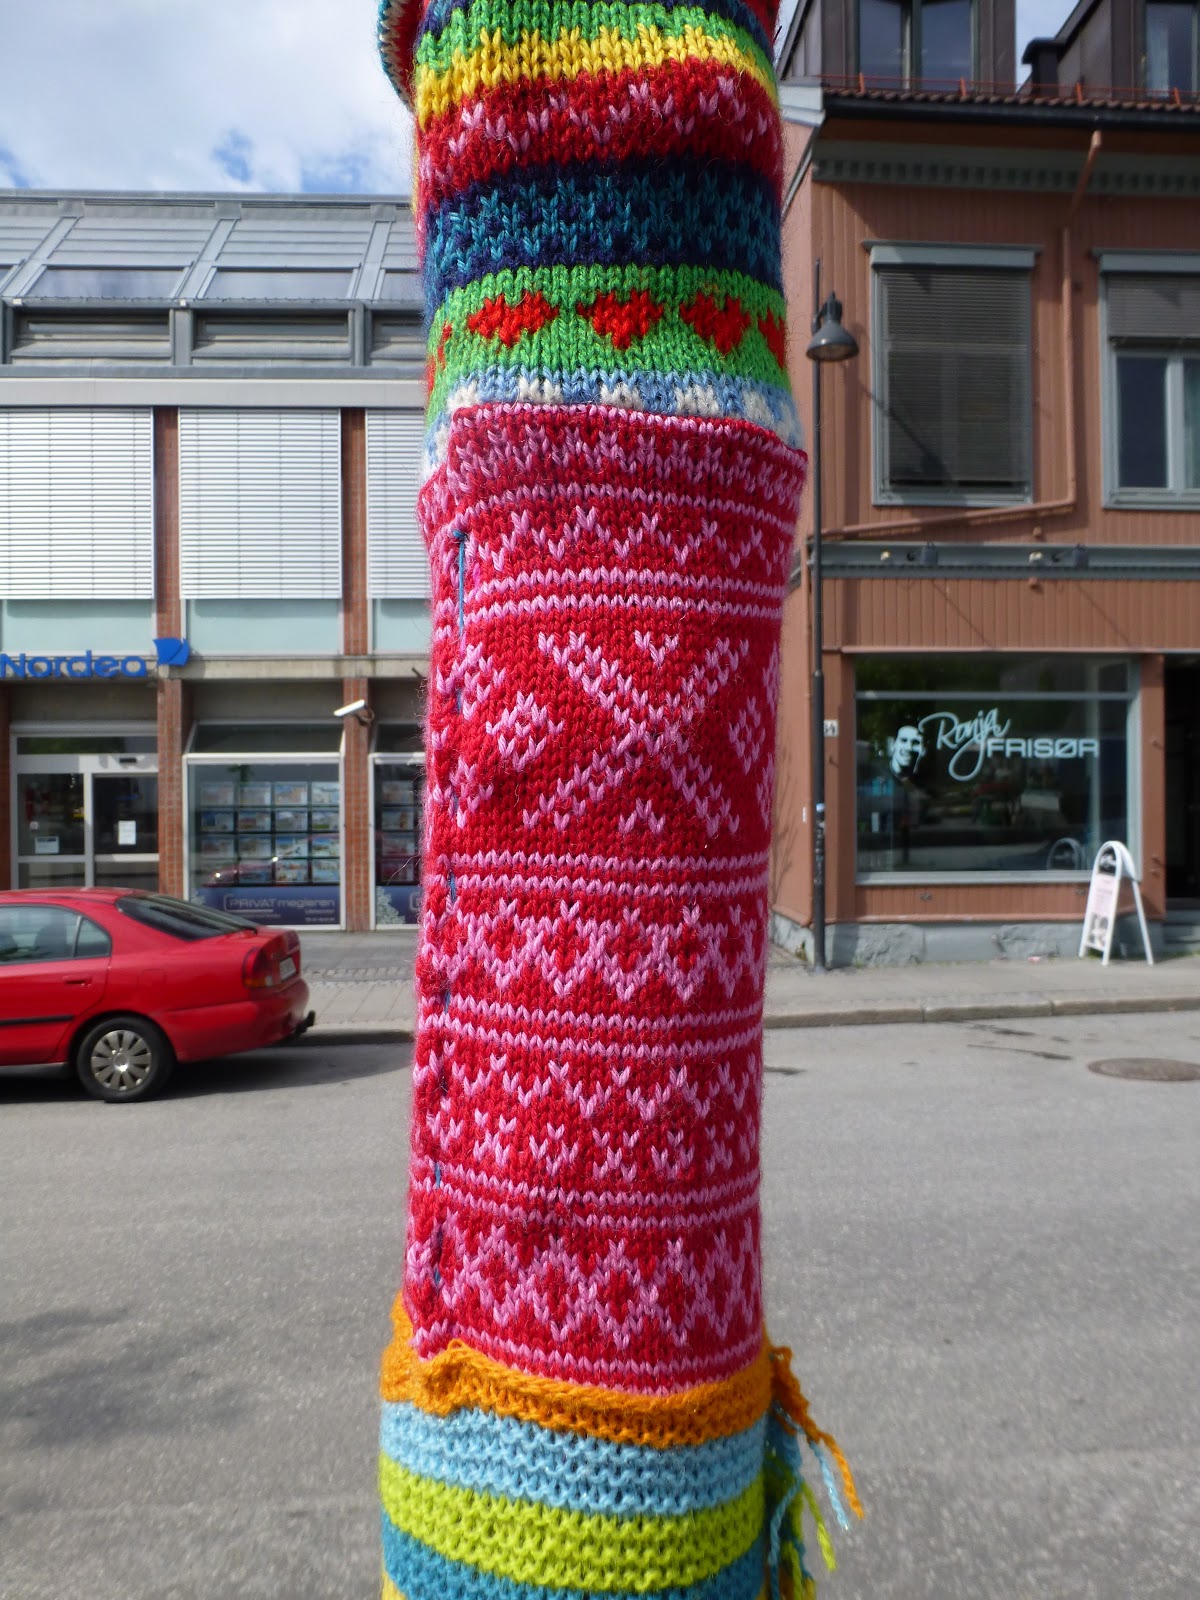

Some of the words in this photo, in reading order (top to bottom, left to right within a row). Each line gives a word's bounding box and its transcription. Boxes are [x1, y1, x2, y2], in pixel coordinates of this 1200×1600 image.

[0, 650, 147, 679] Nordea
[918, 708, 1011, 781] Ronja
[987, 738, 1099, 758] FRISØR
